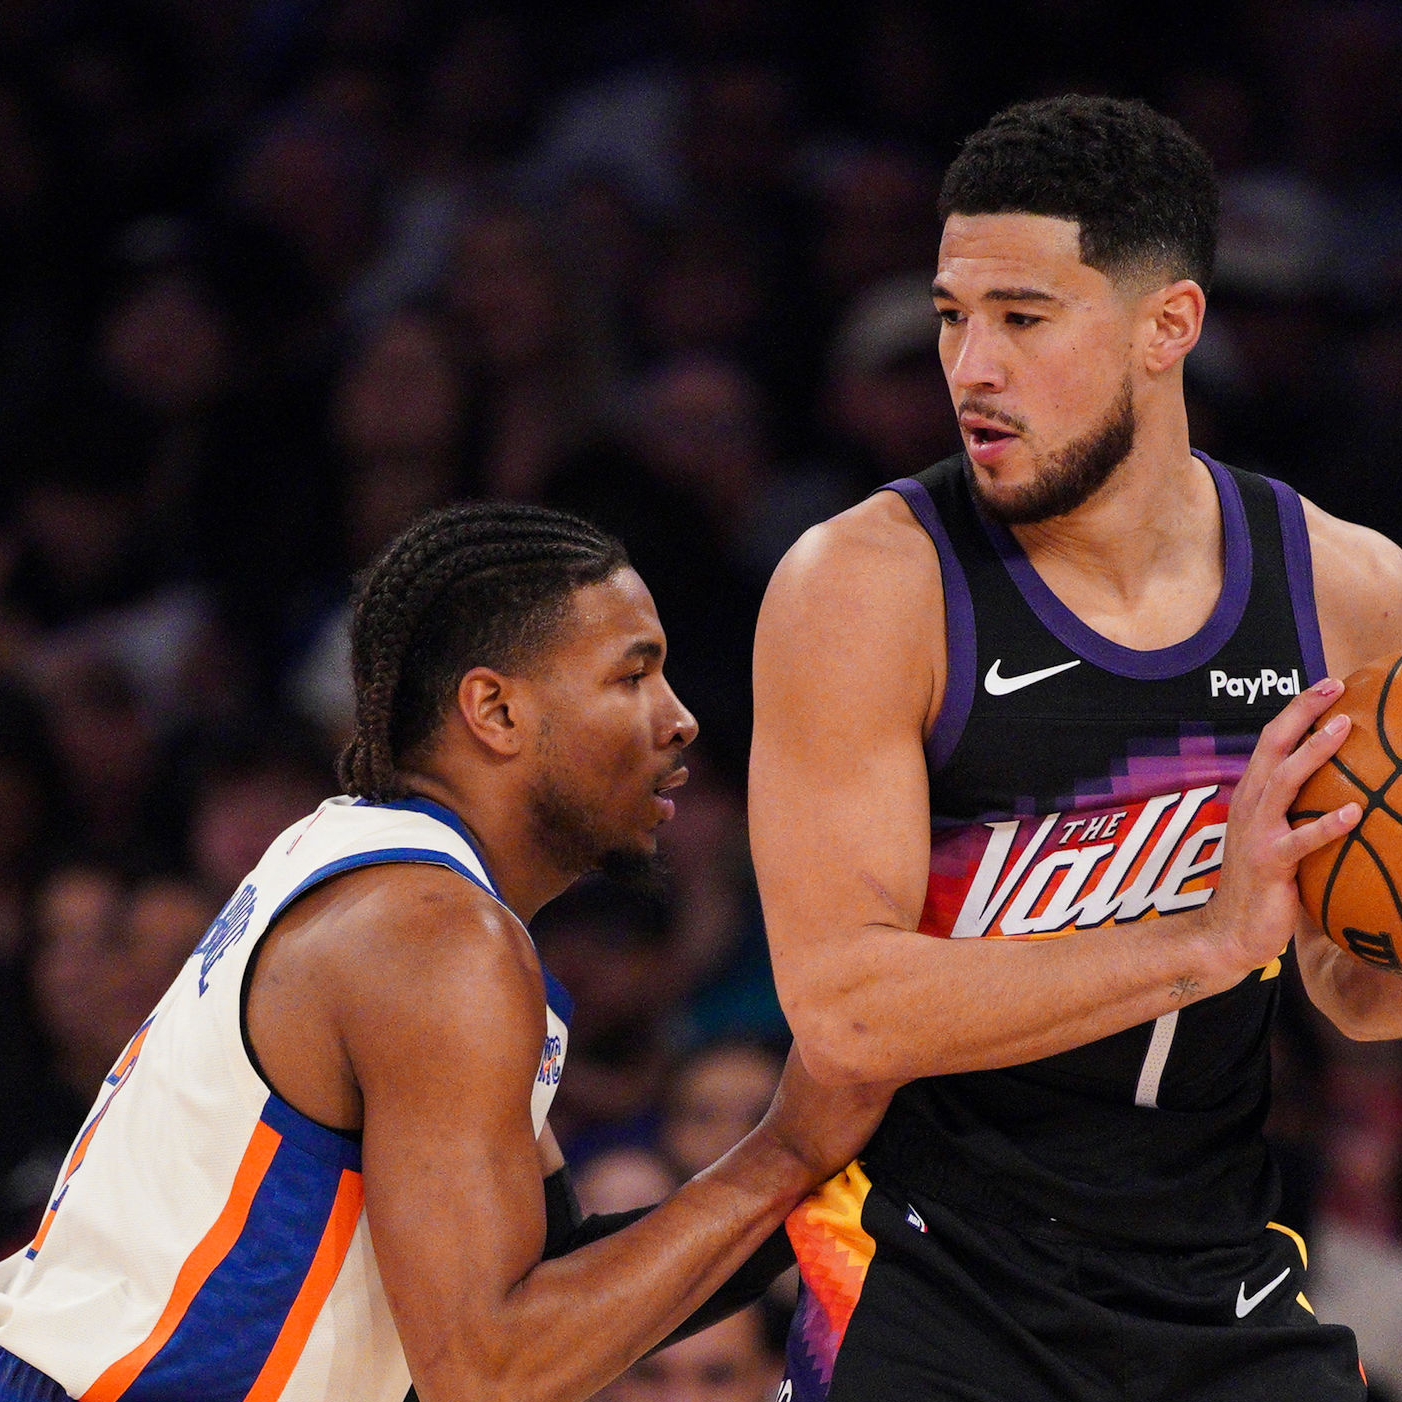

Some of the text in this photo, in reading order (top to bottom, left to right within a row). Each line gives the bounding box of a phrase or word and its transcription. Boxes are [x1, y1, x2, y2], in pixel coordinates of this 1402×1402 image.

[1209, 668, 1301, 705] PayPal
[1058, 811, 1128, 845] THE
[949, 784, 1229, 939] Valle
